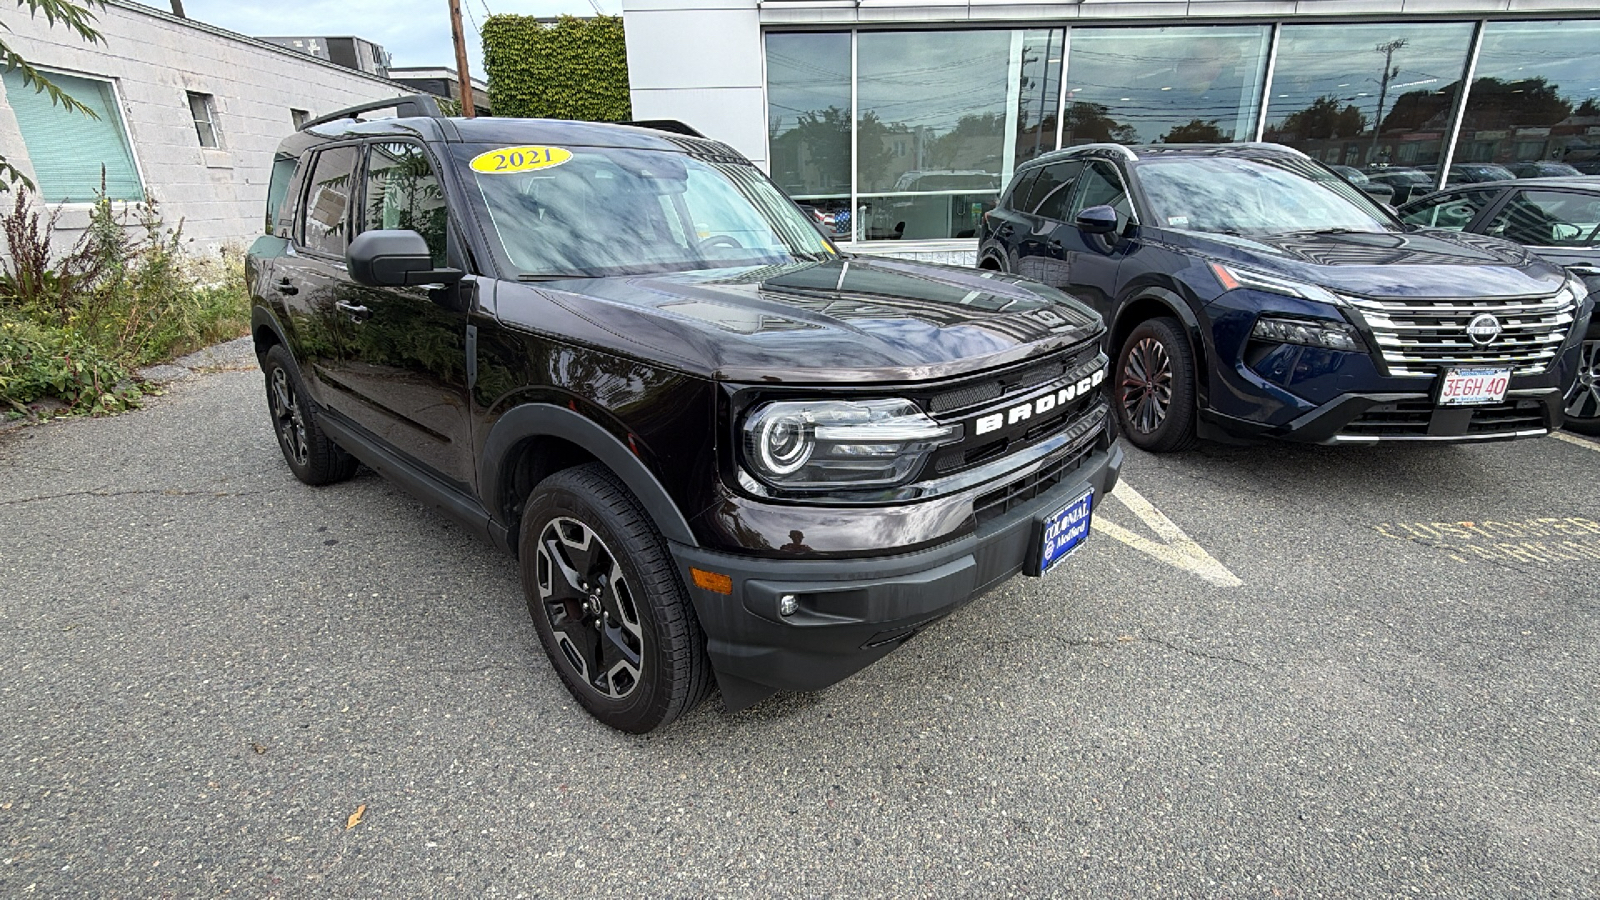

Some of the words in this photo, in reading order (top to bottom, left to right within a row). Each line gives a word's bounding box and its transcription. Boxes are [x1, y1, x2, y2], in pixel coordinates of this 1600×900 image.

[492, 148, 554, 171] 2021
[975, 369, 1104, 436] BRONCO
[1443, 377, 1484, 397] 3EGH
[1485, 377, 1507, 396] 40
[1044, 502, 1089, 544] COLONIAL
